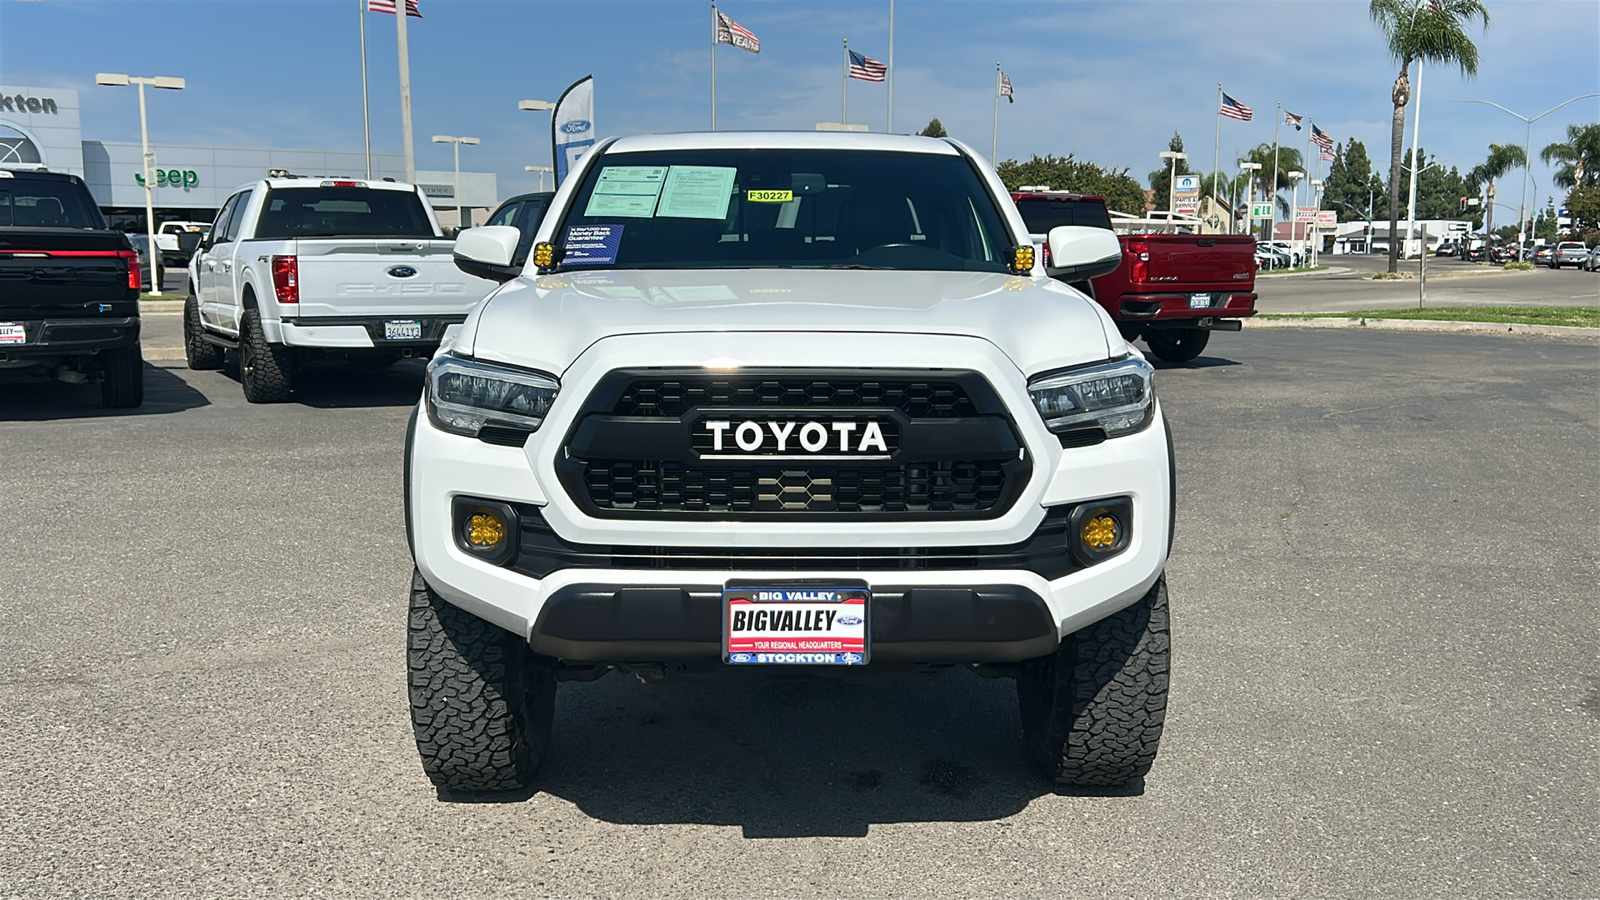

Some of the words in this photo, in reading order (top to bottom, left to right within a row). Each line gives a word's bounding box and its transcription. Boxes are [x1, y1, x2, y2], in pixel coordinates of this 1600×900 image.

[566, 121, 587, 133] Ford
[749, 191, 789, 200] F30227
[337, 282, 467, 296] F-150
[386, 327, 420, 337] 36441Y3
[705, 420, 888, 452] TOYOTA
[759, 592, 783, 601] BIG
[786, 592, 835, 601] VALLEY
[754, 641, 769, 649] YOUR
[770, 641, 798, 649] REGIONAL
[798, 641, 842, 649] HEADQUARTERS
[757, 653, 836, 663] STOCKTON
